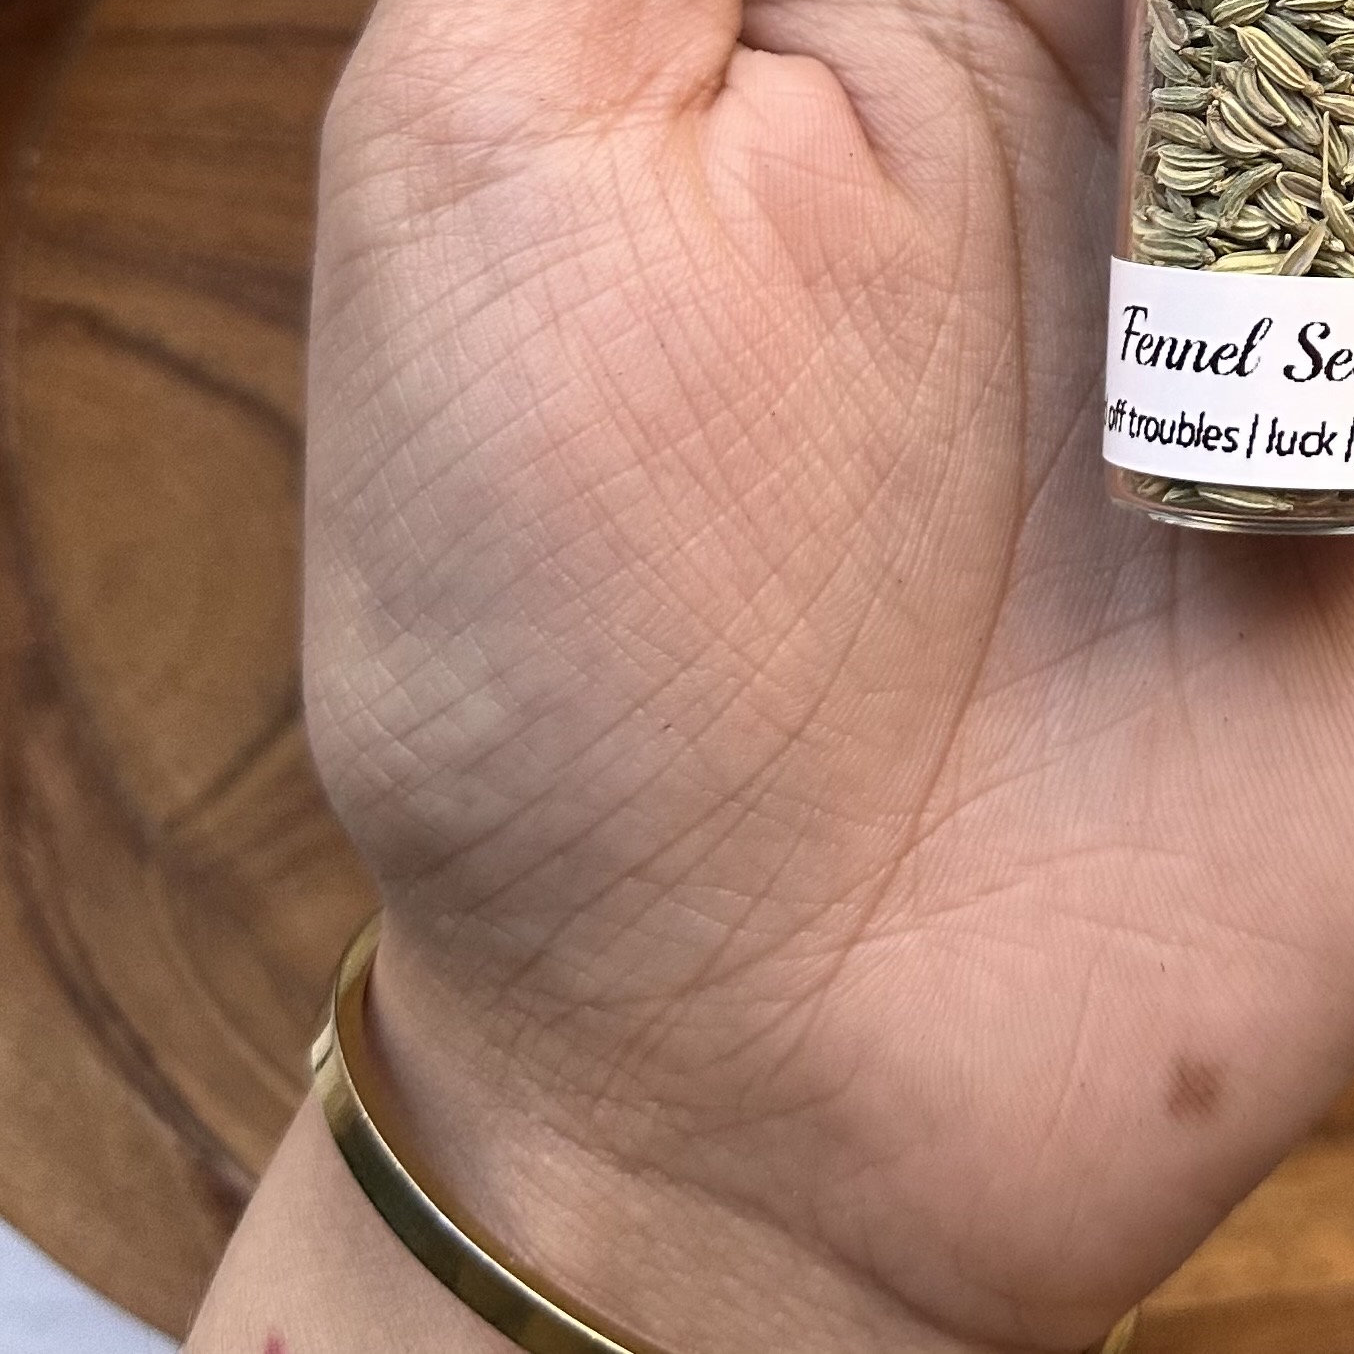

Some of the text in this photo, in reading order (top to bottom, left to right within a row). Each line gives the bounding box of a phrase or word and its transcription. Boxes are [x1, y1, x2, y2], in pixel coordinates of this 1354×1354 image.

[1119, 305, 1274, 378] Fennel
[1108, 398, 1128, 433] off
[1128, 406, 1241, 454] troubles
[1265, 416, 1338, 458] luck
